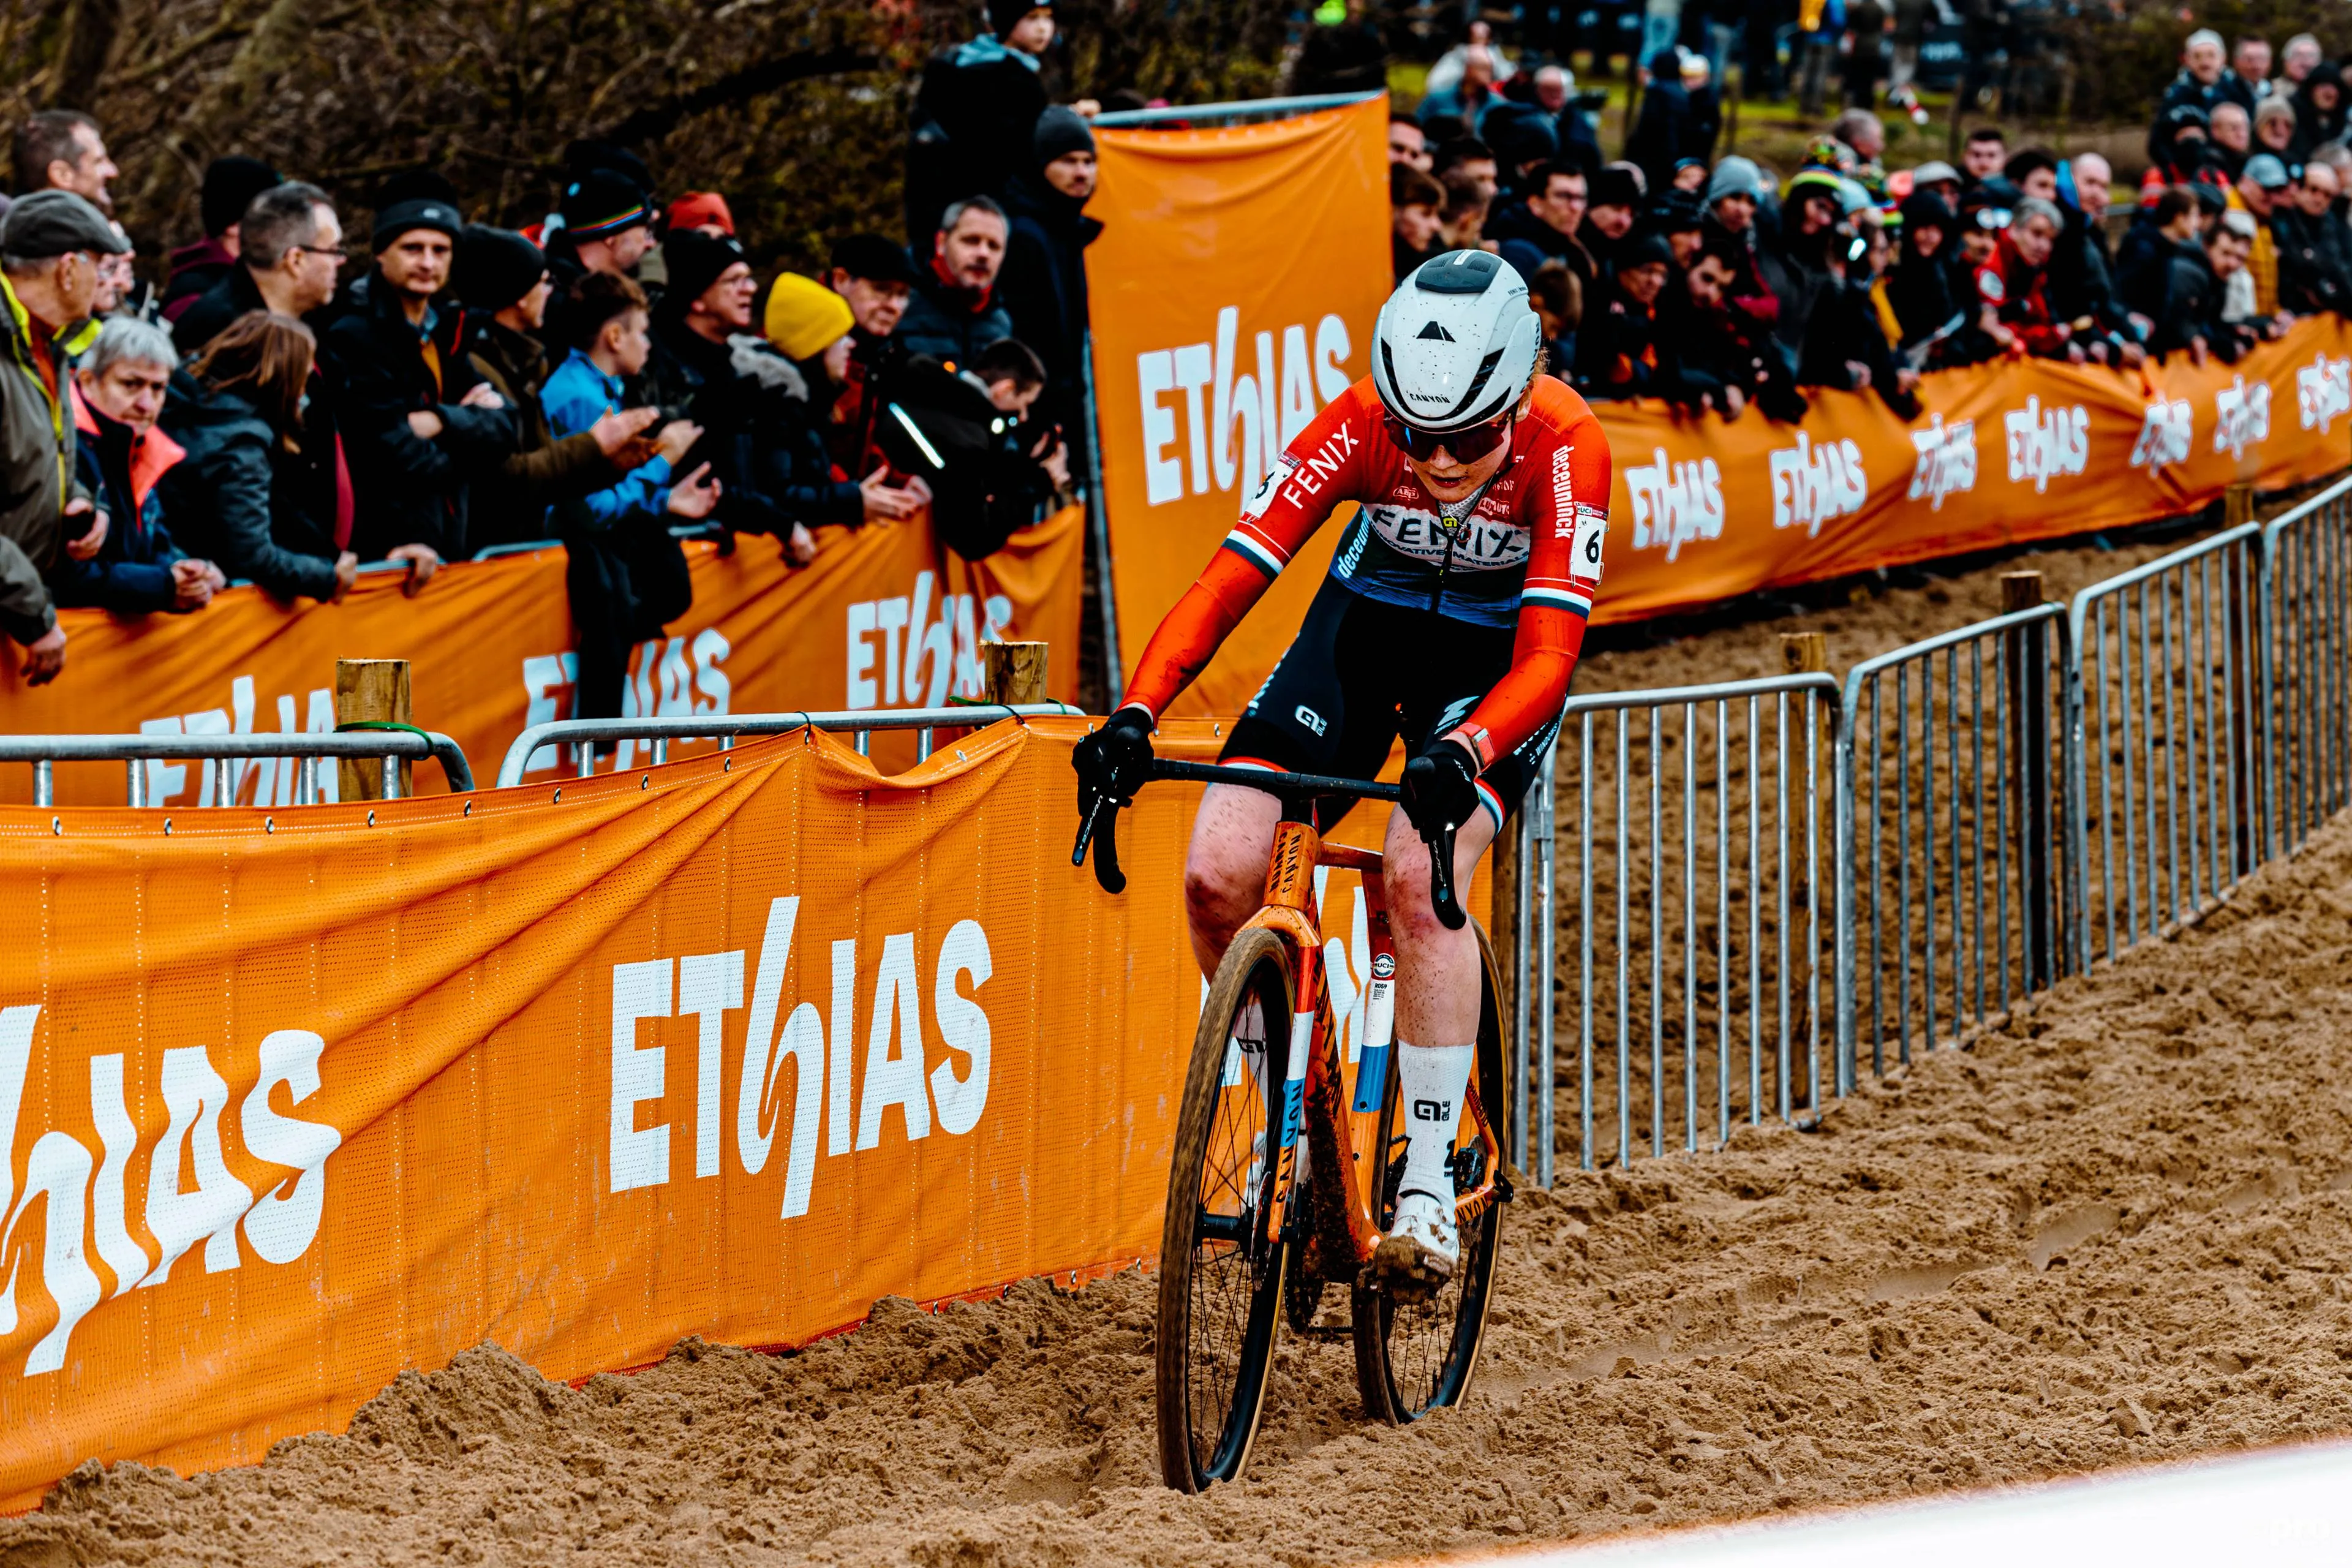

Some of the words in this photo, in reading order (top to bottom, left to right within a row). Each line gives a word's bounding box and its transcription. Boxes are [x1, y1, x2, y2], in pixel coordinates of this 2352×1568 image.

[1409, 393, 1451, 404] CANYON
[1282, 421, 1360, 510] FENIX
[1552, 445, 1575, 539] deceuninck
[1585, 529, 1600, 564] 6
[1281, 834, 1302, 894] CANYON
[1456, 1194, 1489, 1225] NYON
